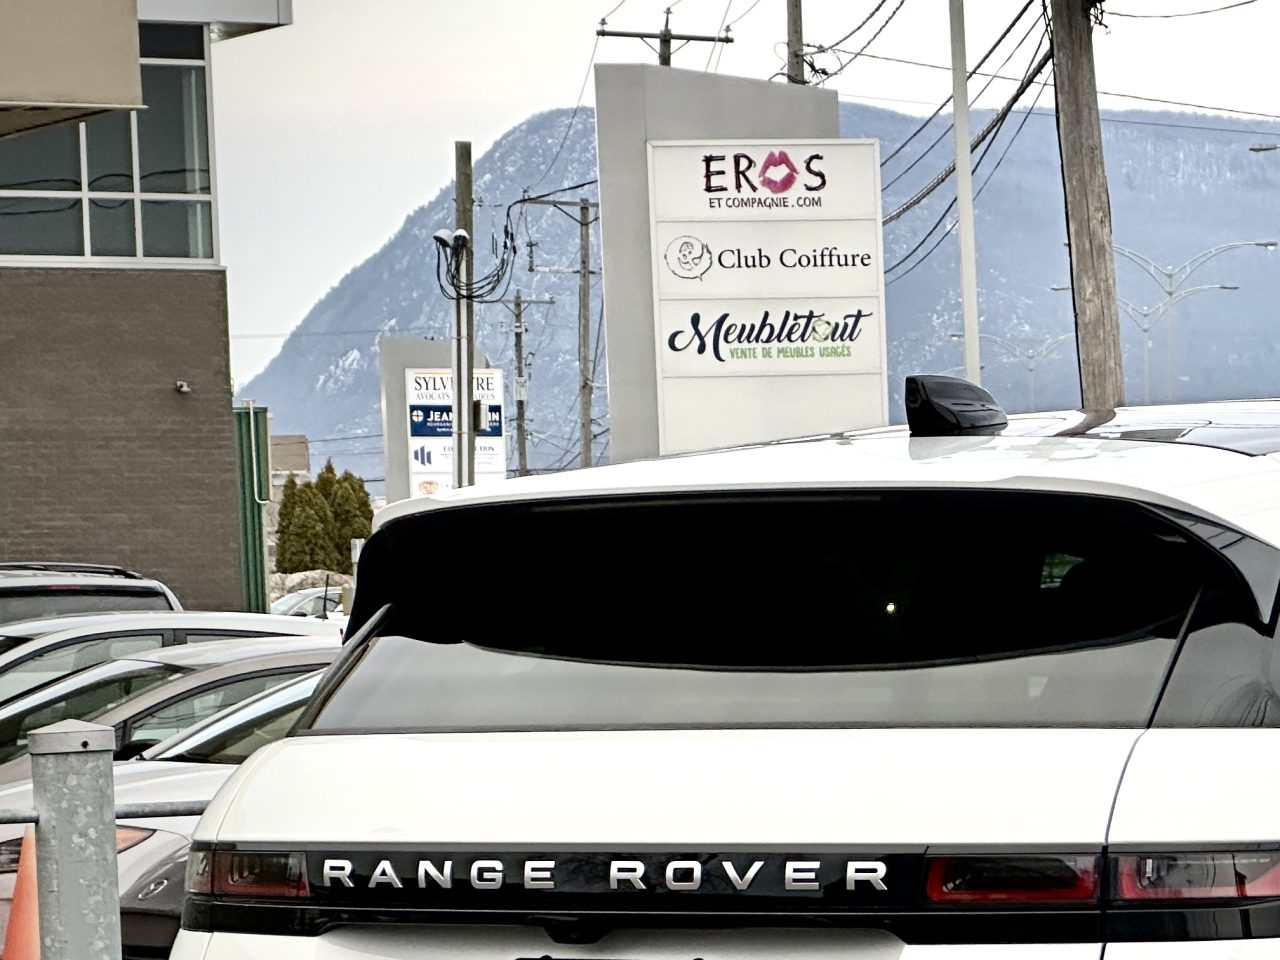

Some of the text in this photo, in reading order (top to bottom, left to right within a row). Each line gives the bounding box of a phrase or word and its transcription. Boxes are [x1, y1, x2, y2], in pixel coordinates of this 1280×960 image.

[702, 150, 827, 194] EROS
[709, 197, 723, 208] ET
[717, 247, 872, 269] Club Coiffure
[729, 347, 758, 359] VENTE
[761, 346, 772, 358] DE
[777, 346, 815, 358] MEUBLES
[323, 859, 888, 891] RANGE ROVER
